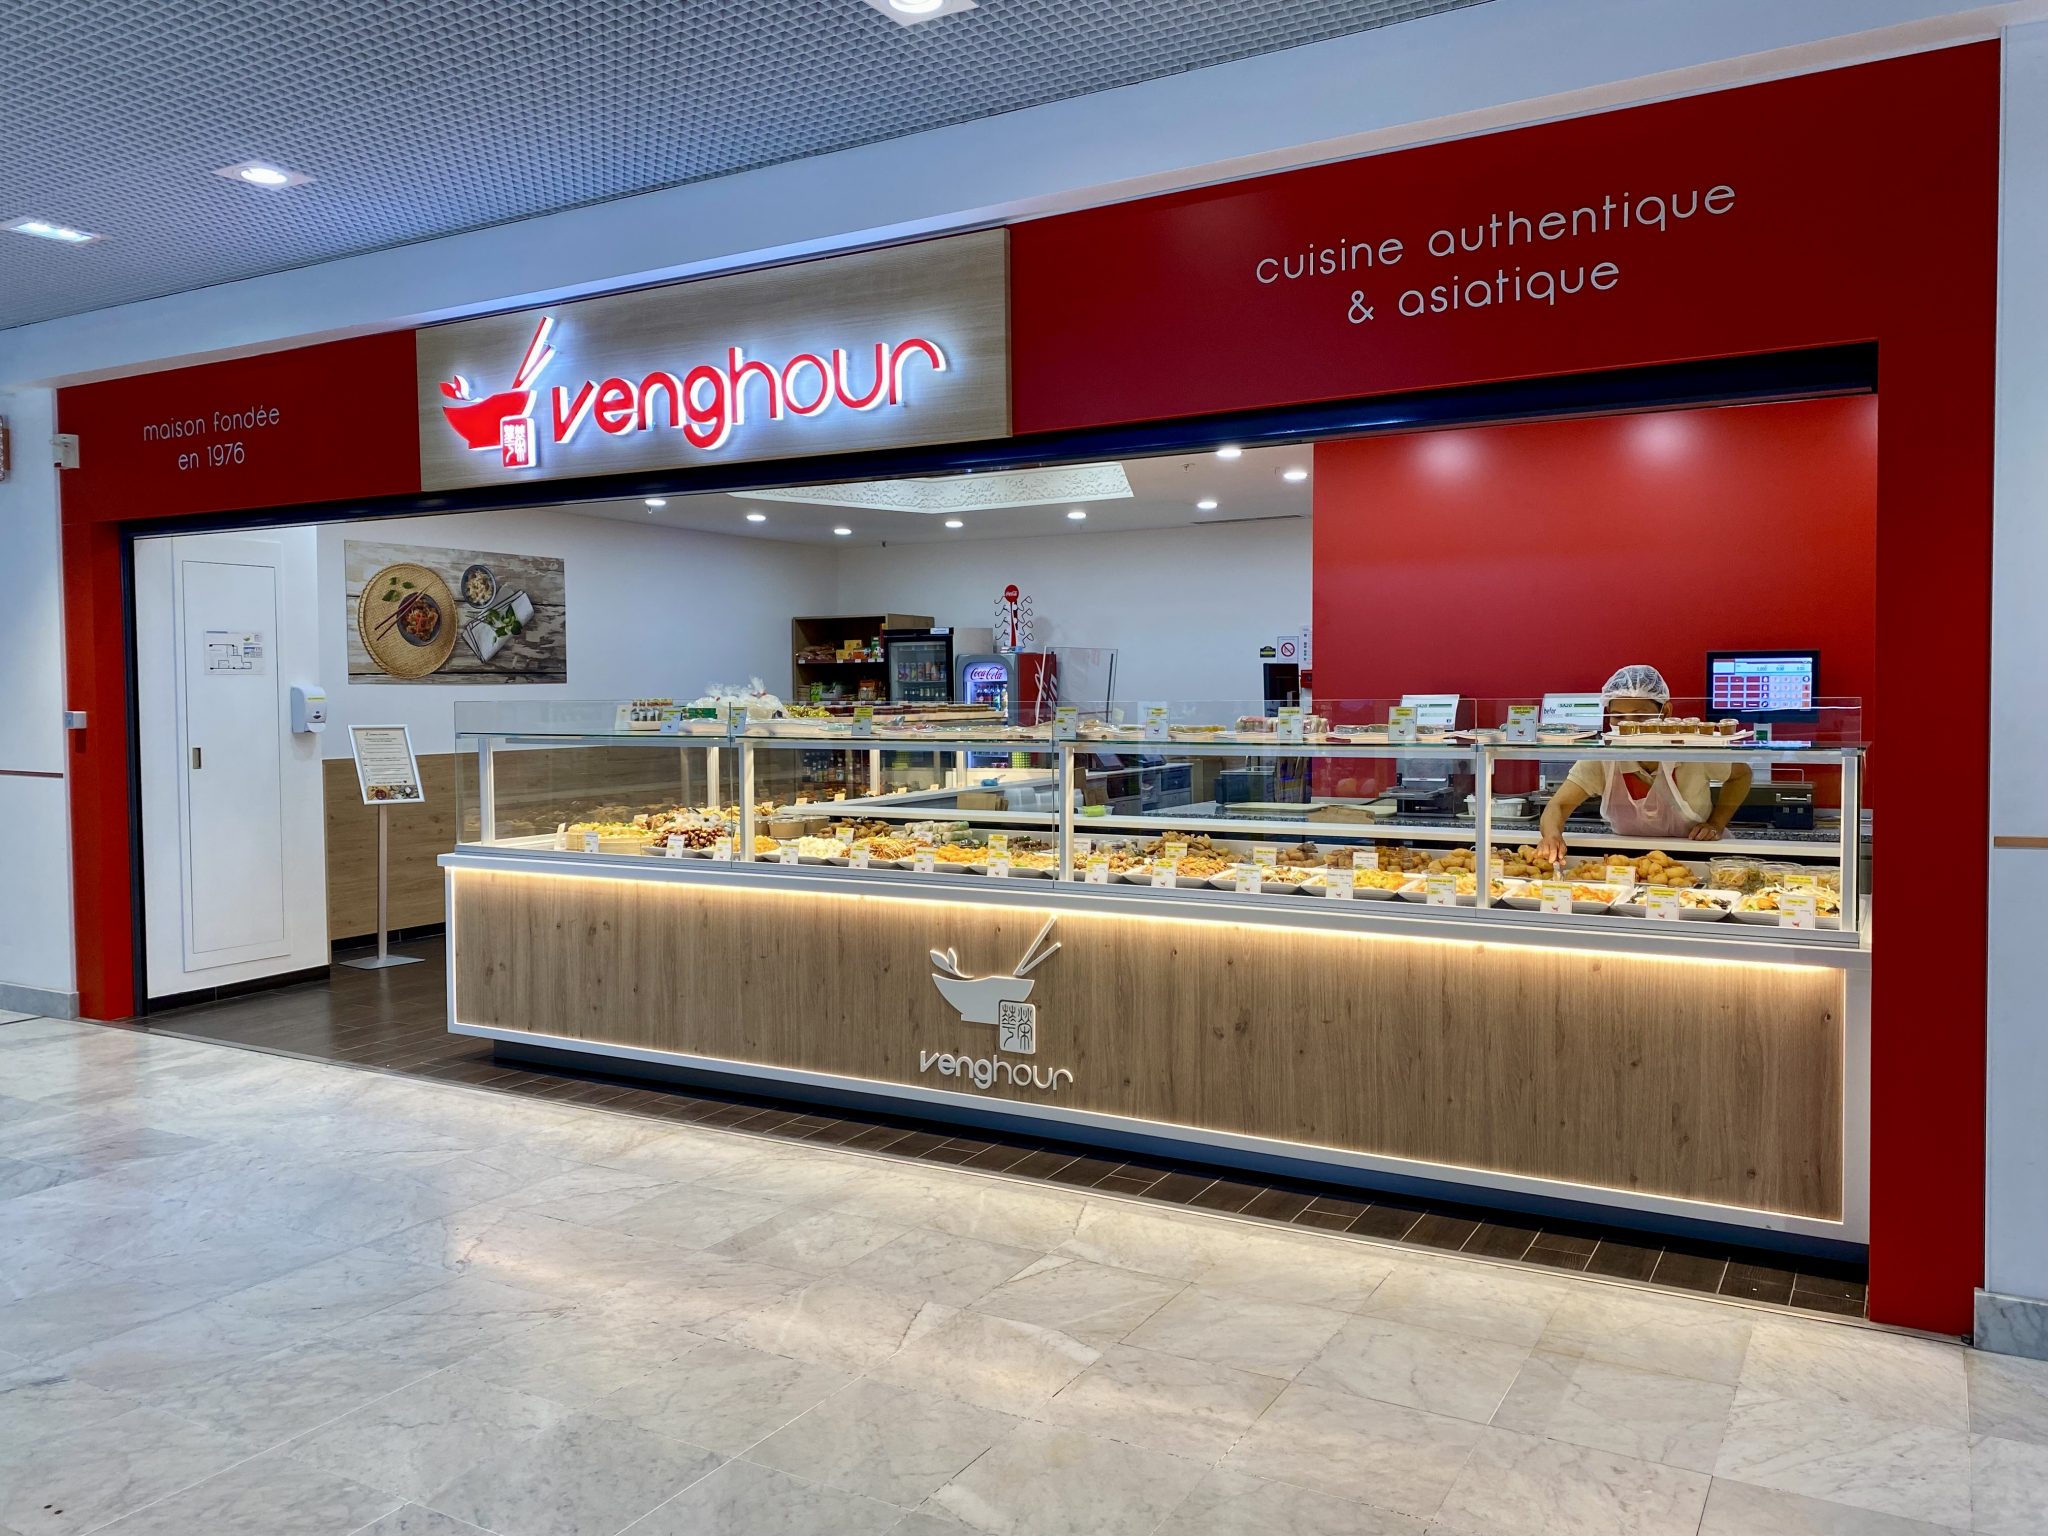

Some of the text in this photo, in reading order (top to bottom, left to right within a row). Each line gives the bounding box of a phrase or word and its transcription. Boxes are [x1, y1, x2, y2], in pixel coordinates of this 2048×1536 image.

[1256, 184, 1736, 284] cuisine authentique
[1347, 261, 1620, 324] & asiatique
[551, 337, 947, 452] venghour
[143, 404, 280, 441] maison fondée
[178, 441, 245, 470] en 1976
[919, 1050, 1074, 1091] venghour
